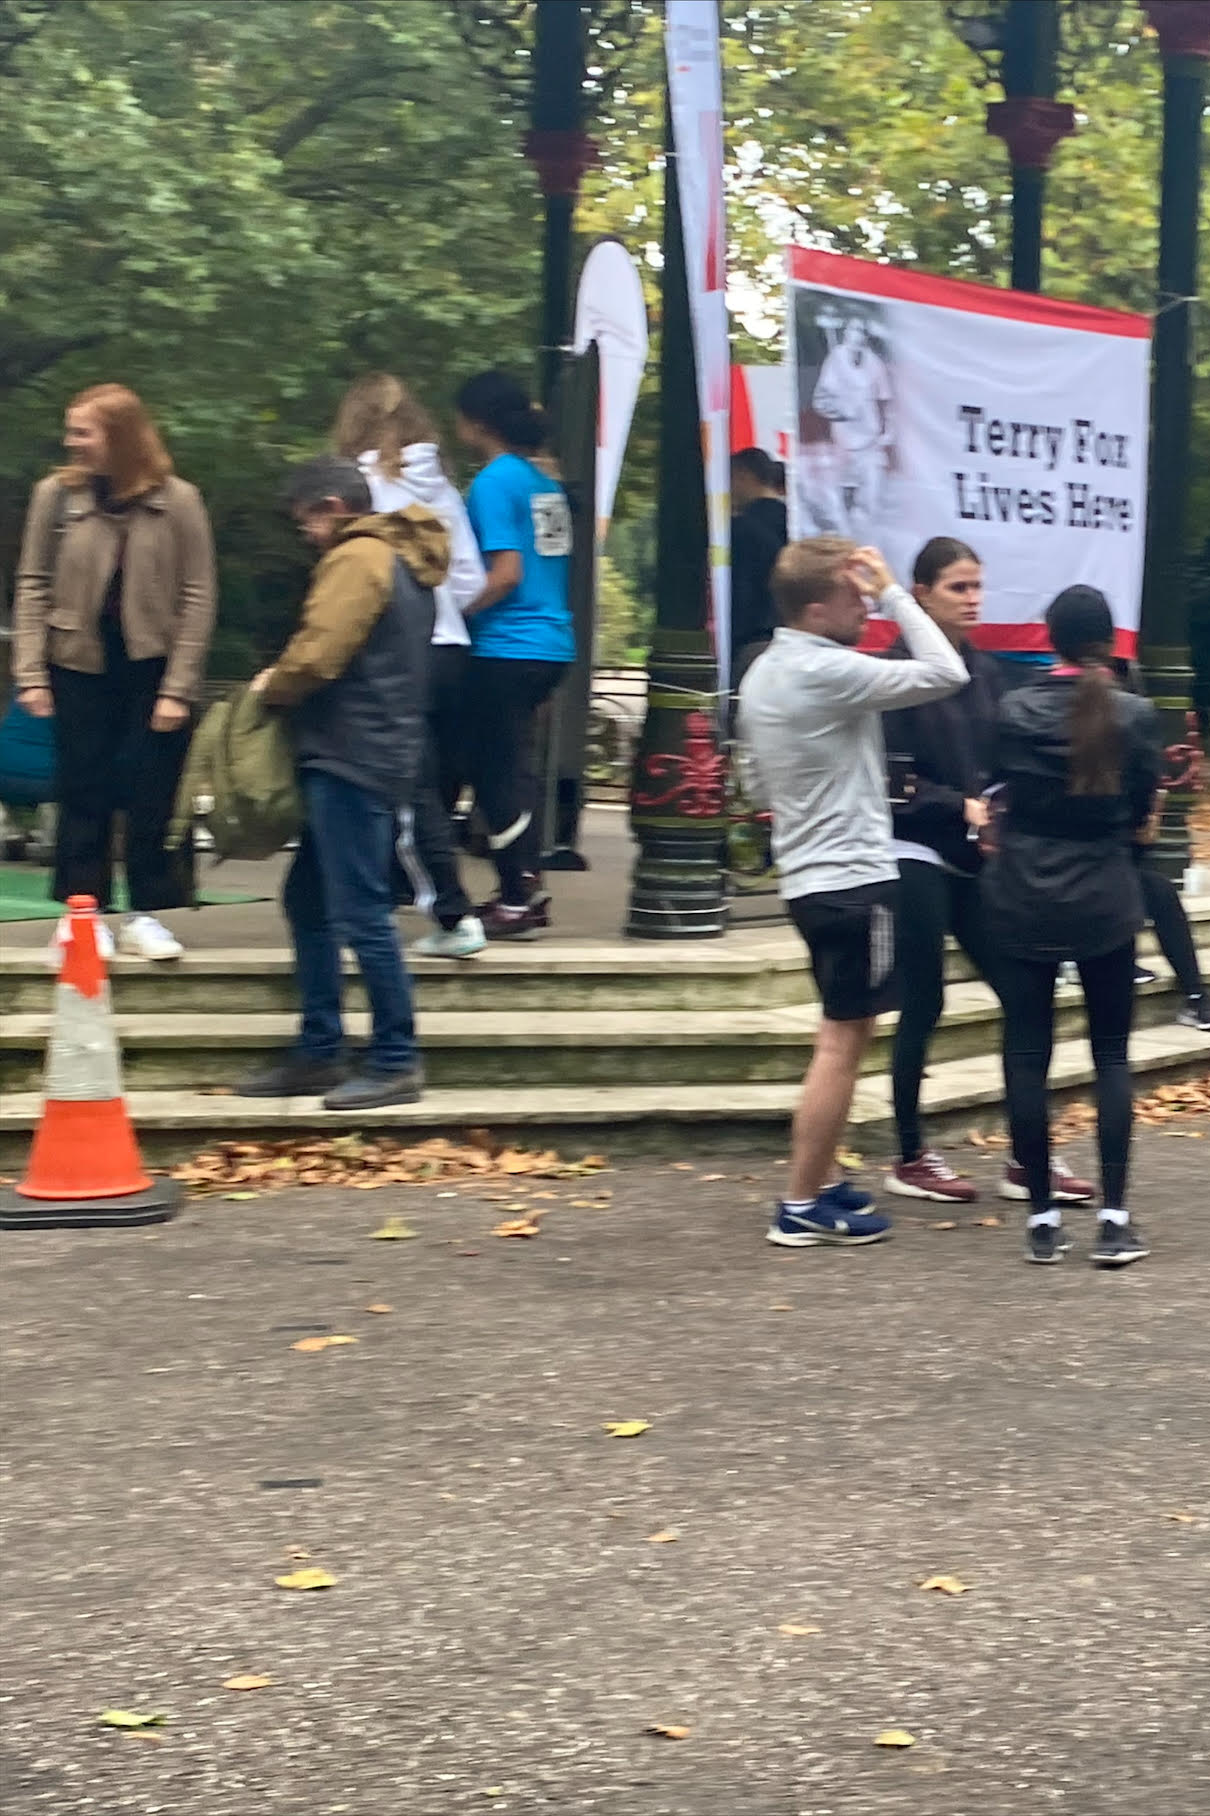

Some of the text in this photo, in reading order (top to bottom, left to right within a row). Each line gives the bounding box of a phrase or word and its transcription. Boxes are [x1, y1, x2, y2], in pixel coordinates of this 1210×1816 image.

[959, 405, 1129, 470] Terry Fox
[952, 472, 1133, 532] Lives Here
